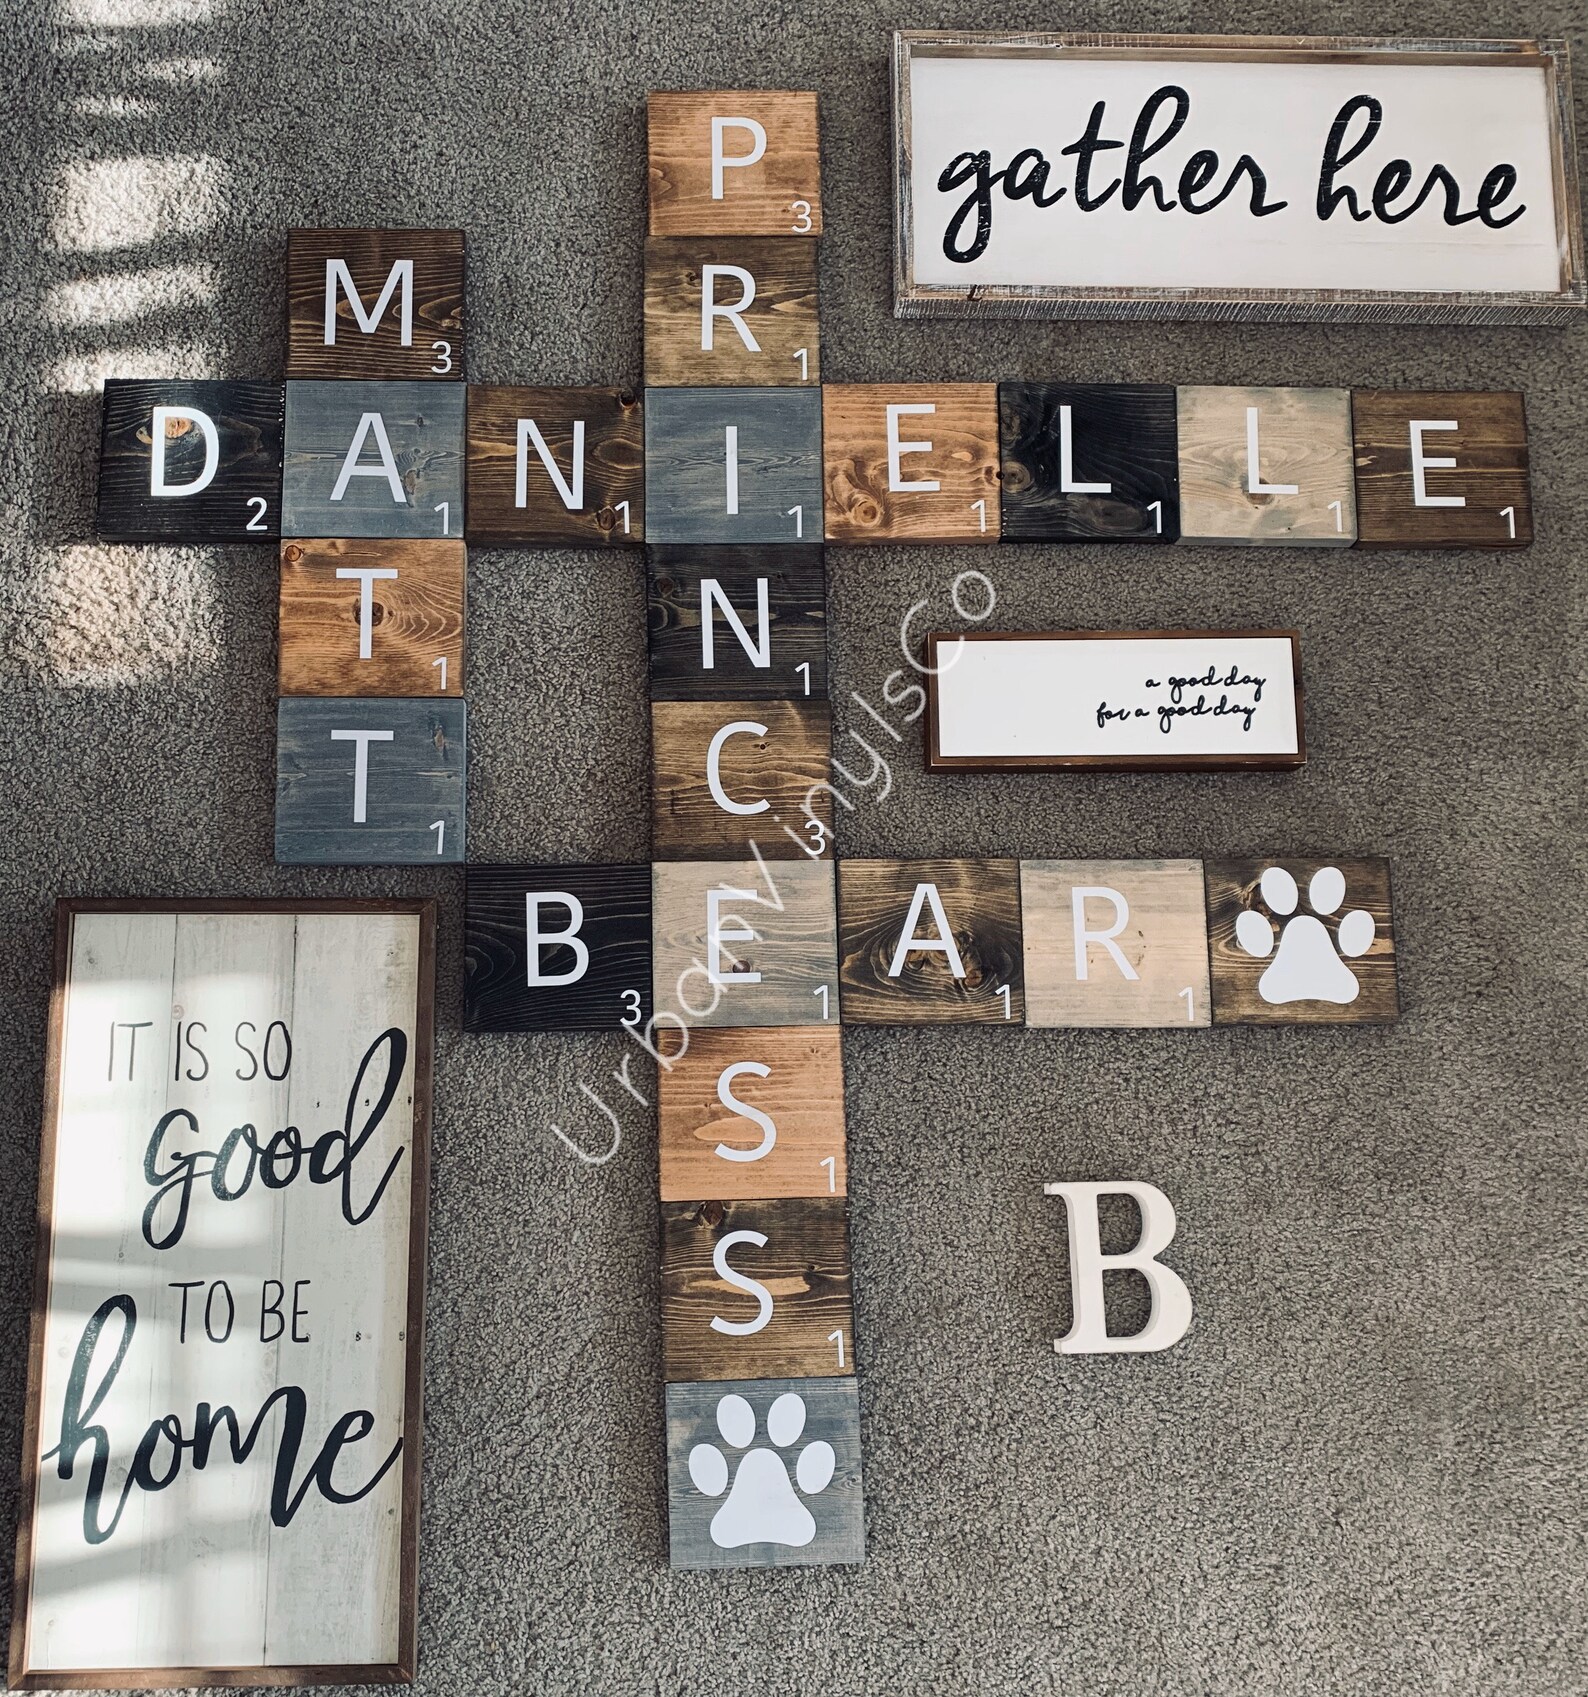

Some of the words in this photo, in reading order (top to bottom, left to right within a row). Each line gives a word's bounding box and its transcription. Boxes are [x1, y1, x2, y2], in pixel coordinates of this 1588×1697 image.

[708, 116, 767, 200] P
[938, 85, 1287, 263] gather
[1316, 94, 1527, 229] here
[790, 200, 812, 233] 3
[324, 259, 414, 346] M
[701, 264, 762, 352] R
[430, 341, 452, 374] 3
[791, 348, 808, 381] 1
[150, 406, 220, 497] D
[329, 412, 407, 503] A
[515, 418, 585, 510] N
[725, 425, 740, 515] I
[885, 403, 941, 492] E
[1059, 405, 1112, 493] L
[1245, 406, 1299, 495] L
[1409, 420, 1466, 507] E
[245, 497, 268, 531] 2
[433, 501, 449, 535] 1
[613, 500, 630, 534] 1
[786, 505, 802, 538] 1
[969, 499, 987, 532] 1
[1145, 500, 1162, 534] 1
[1326, 499, 1343, 533] 1
[1498, 506, 1516, 539] 1
[335, 568, 399, 659] T
[700, 577, 771, 669] N
[431, 656, 447, 690] 1
[793, 662, 810, 696] 1
[1145, 679, 1161, 688] a
[1168, 665, 1223, 704] good
[1224, 665, 1266, 702] day
[1097, 701, 1130, 728] for
[1135, 708, 1150, 717] a
[1157, 695, 1212, 734] good
[1213, 695, 1256, 731] day
[331, 729, 394, 823] T
[706, 721, 771, 815] C
[428, 820, 445, 855] 1
[803, 820, 827, 856] 3
[526, 891, 589, 987] B
[707, 889, 762, 984] E
[887, 883, 967, 978] A
[1071, 886, 1139, 982] R
[618, 989, 642, 1027] 3
[812, 984, 829, 1020] 1
[993, 984, 1011, 1020] 1
[1177, 986, 1195, 1022] 1
[107, 1020, 154, 1082] IT
[174, 1021, 209, 1082] IS
[235, 1020, 292, 1082] SO
[714, 1061, 777, 1163] S
[818, 1156, 836, 1193] 1
[709, 1230, 774, 1336] S
[1043, 1181, 1193, 1354] B
[169, 1280, 232, 1344] TO
[260, 1279, 311, 1343] BE
[826, 1329, 845, 1368] 1
[41, 1295, 404, 1545] home
